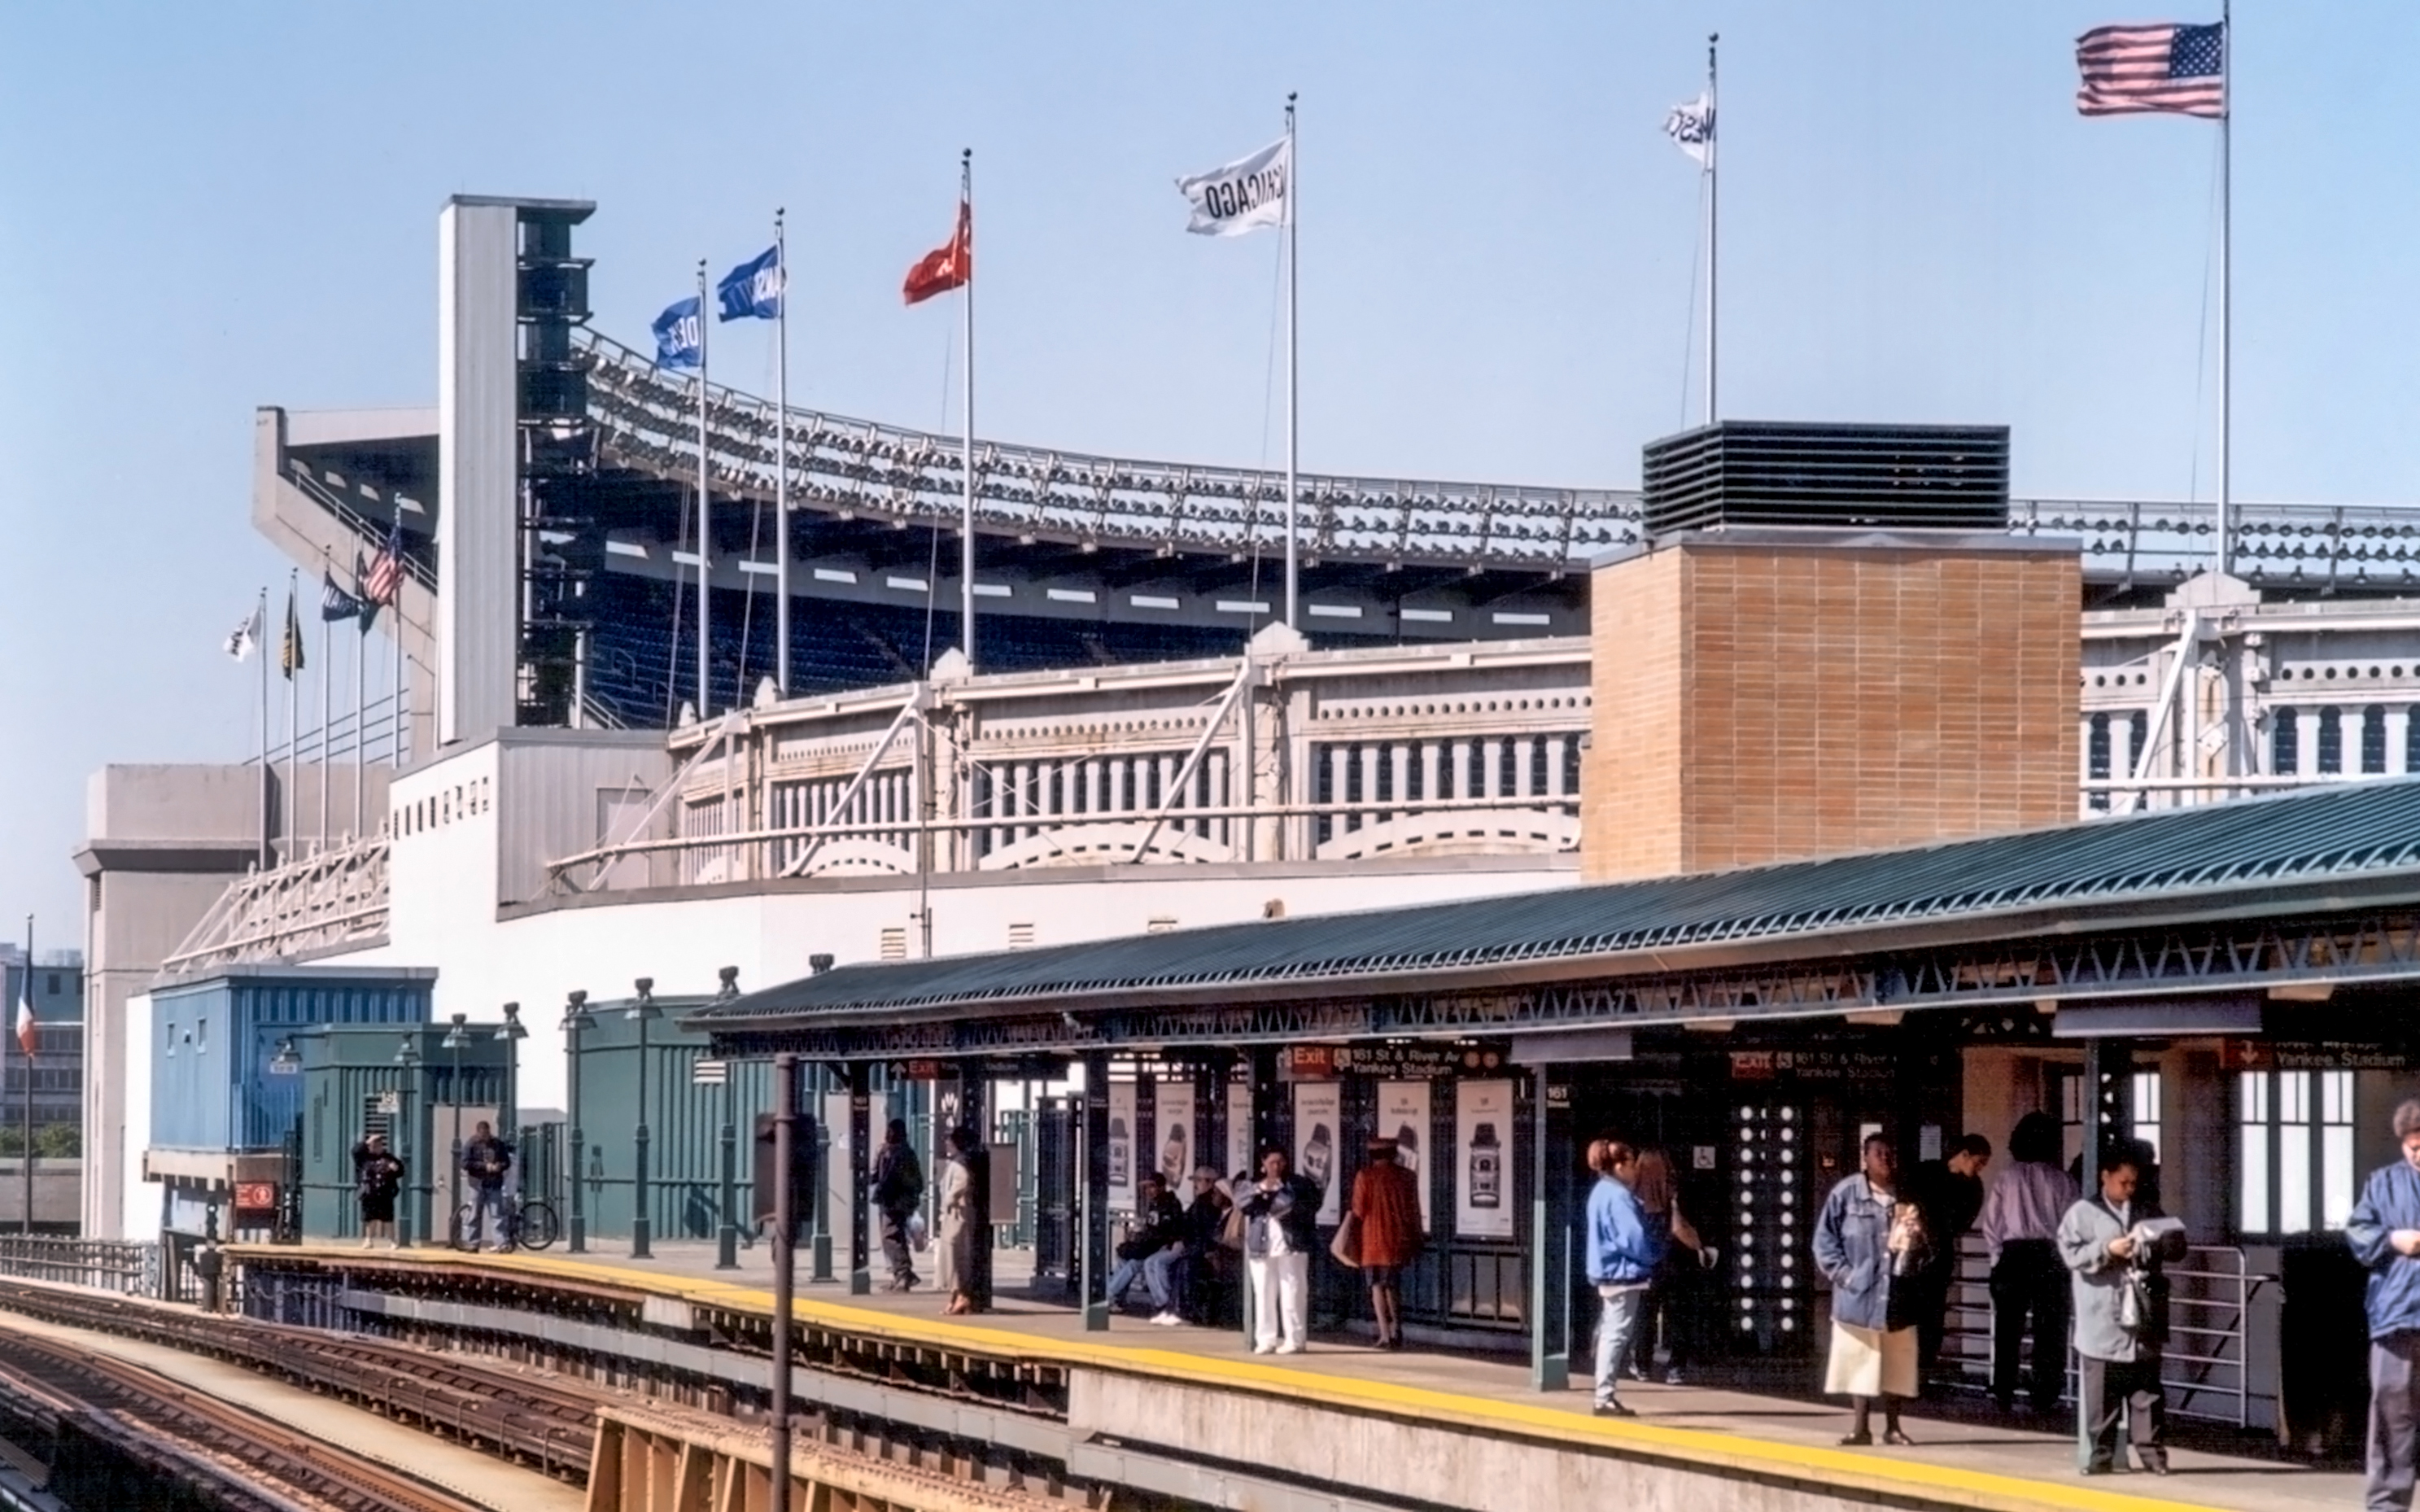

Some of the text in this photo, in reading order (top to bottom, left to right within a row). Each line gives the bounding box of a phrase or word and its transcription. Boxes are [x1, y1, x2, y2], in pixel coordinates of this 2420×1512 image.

[1294, 1047, 1326, 1064] Exit
[1352, 1049, 1372, 1061] 161
[1376, 1048, 1390, 1061] St
[1395, 1049, 1404, 1061] &
[1409, 1049, 1440, 1062] River
[1444, 1051, 1461, 1063] Av
[2276, 1051, 2406, 1067] Yankee Stadium
[908, 1060, 936, 1074] Exit
[1352, 1062, 1452, 1075] Yankee Stadium
[1796, 1066, 1841, 1078] Yankee
[1548, 1086, 1568, 1099] 161
